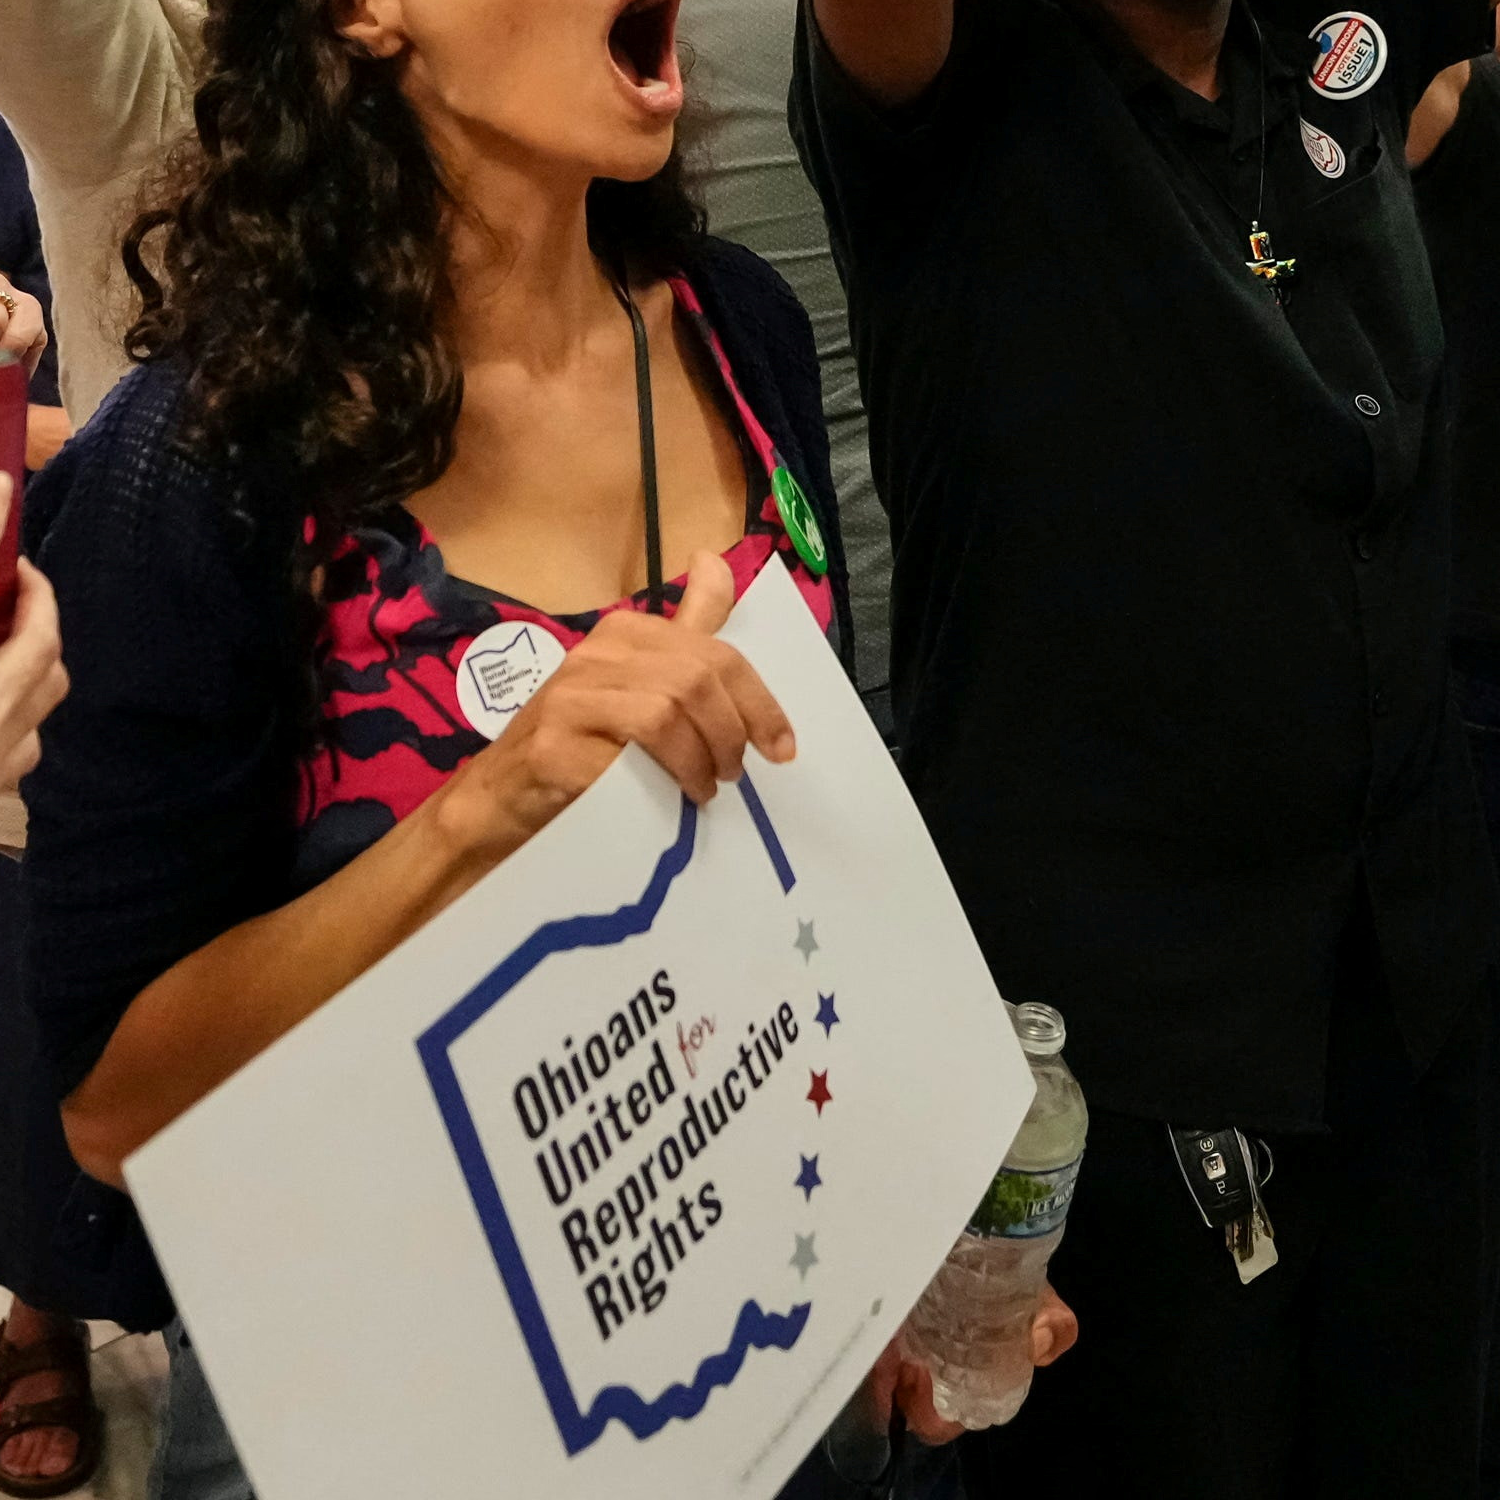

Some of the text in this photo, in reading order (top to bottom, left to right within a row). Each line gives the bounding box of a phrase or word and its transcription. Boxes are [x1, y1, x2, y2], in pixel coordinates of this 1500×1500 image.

[1318, 20, 1359, 82] UNION STRONG
[1335, 42, 1358, 74] VOTE NO
[1338, 47, 1367, 84] ISSUE
[1359, 38, 1372, 47] 1
[512, 968, 677, 1140] Ohioans
[534, 1011, 718, 1208] United for
[560, 996, 800, 1276] Reproductive
[586, 1179, 723, 1340] Rights
